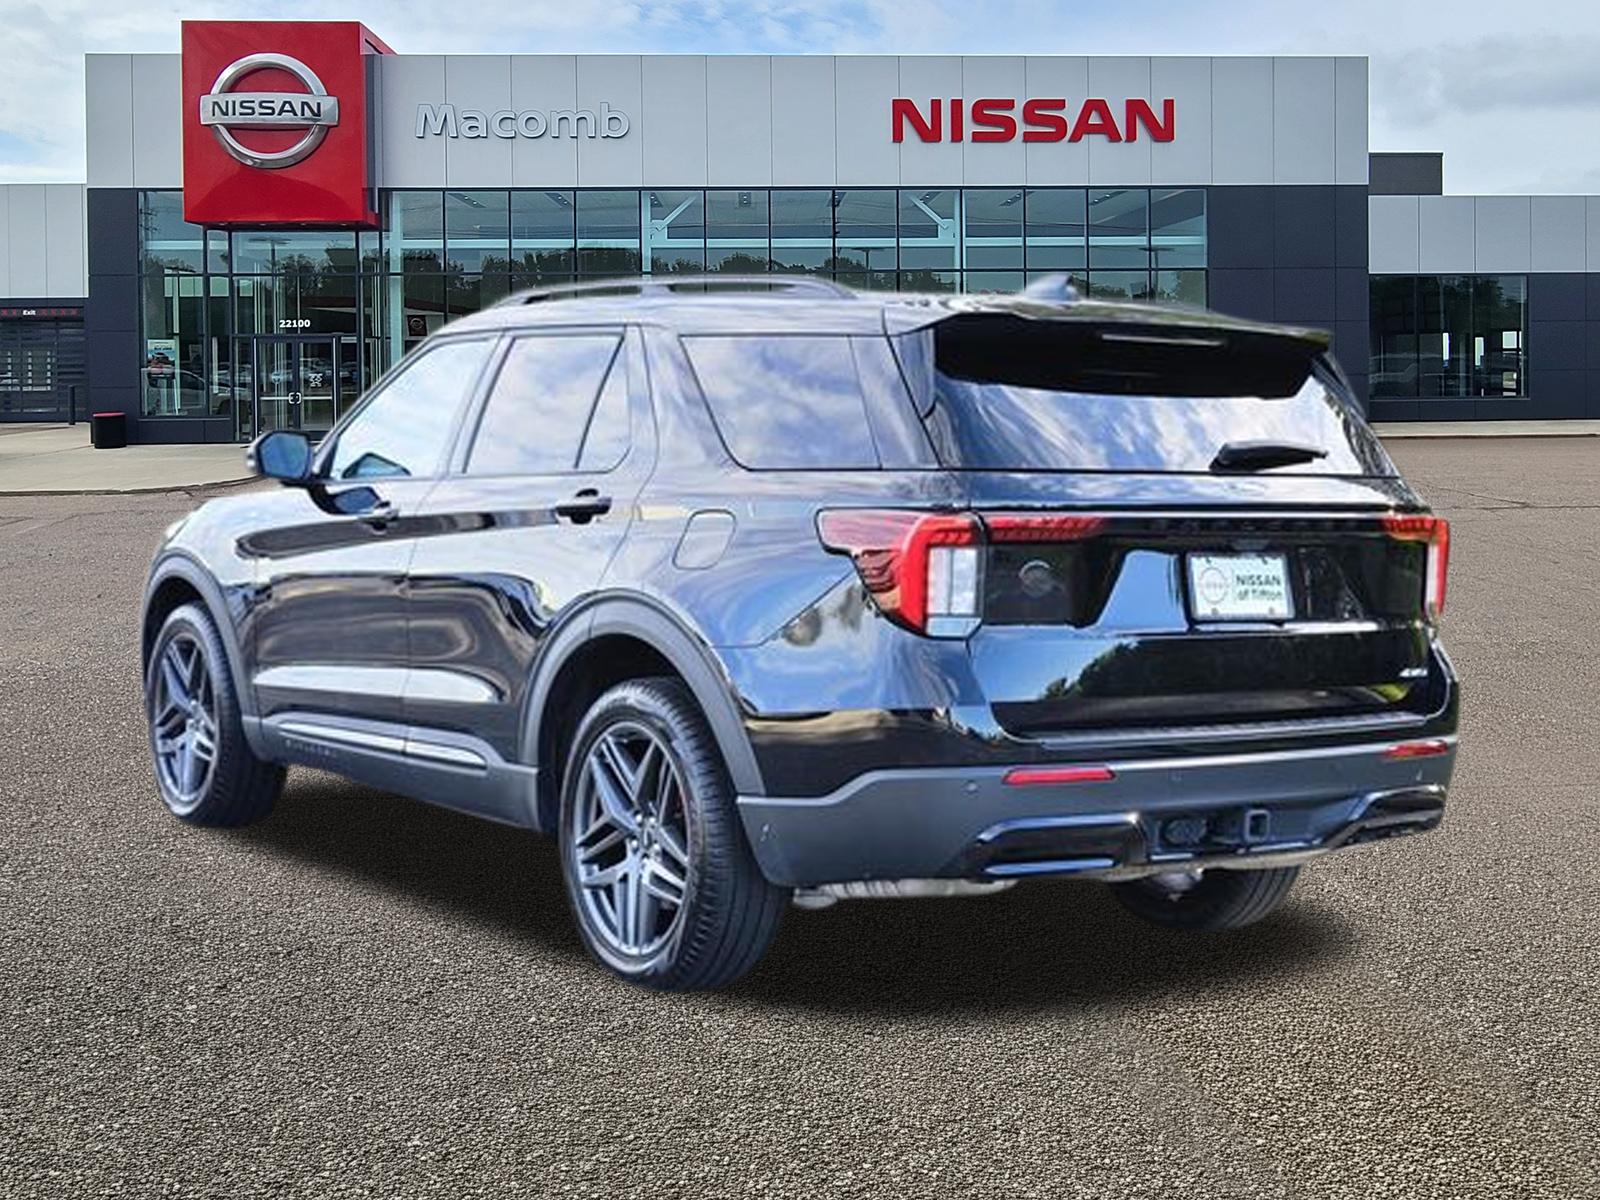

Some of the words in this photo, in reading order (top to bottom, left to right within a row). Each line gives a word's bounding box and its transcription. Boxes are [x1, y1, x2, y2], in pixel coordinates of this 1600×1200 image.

[211, 100, 322, 117] NISSAN
[415, 102, 630, 139] Macomb
[891, 98, 1175, 143] NISSAN
[279, 319, 311, 328] 22100
[1236, 574, 1281, 586] NISSAN
